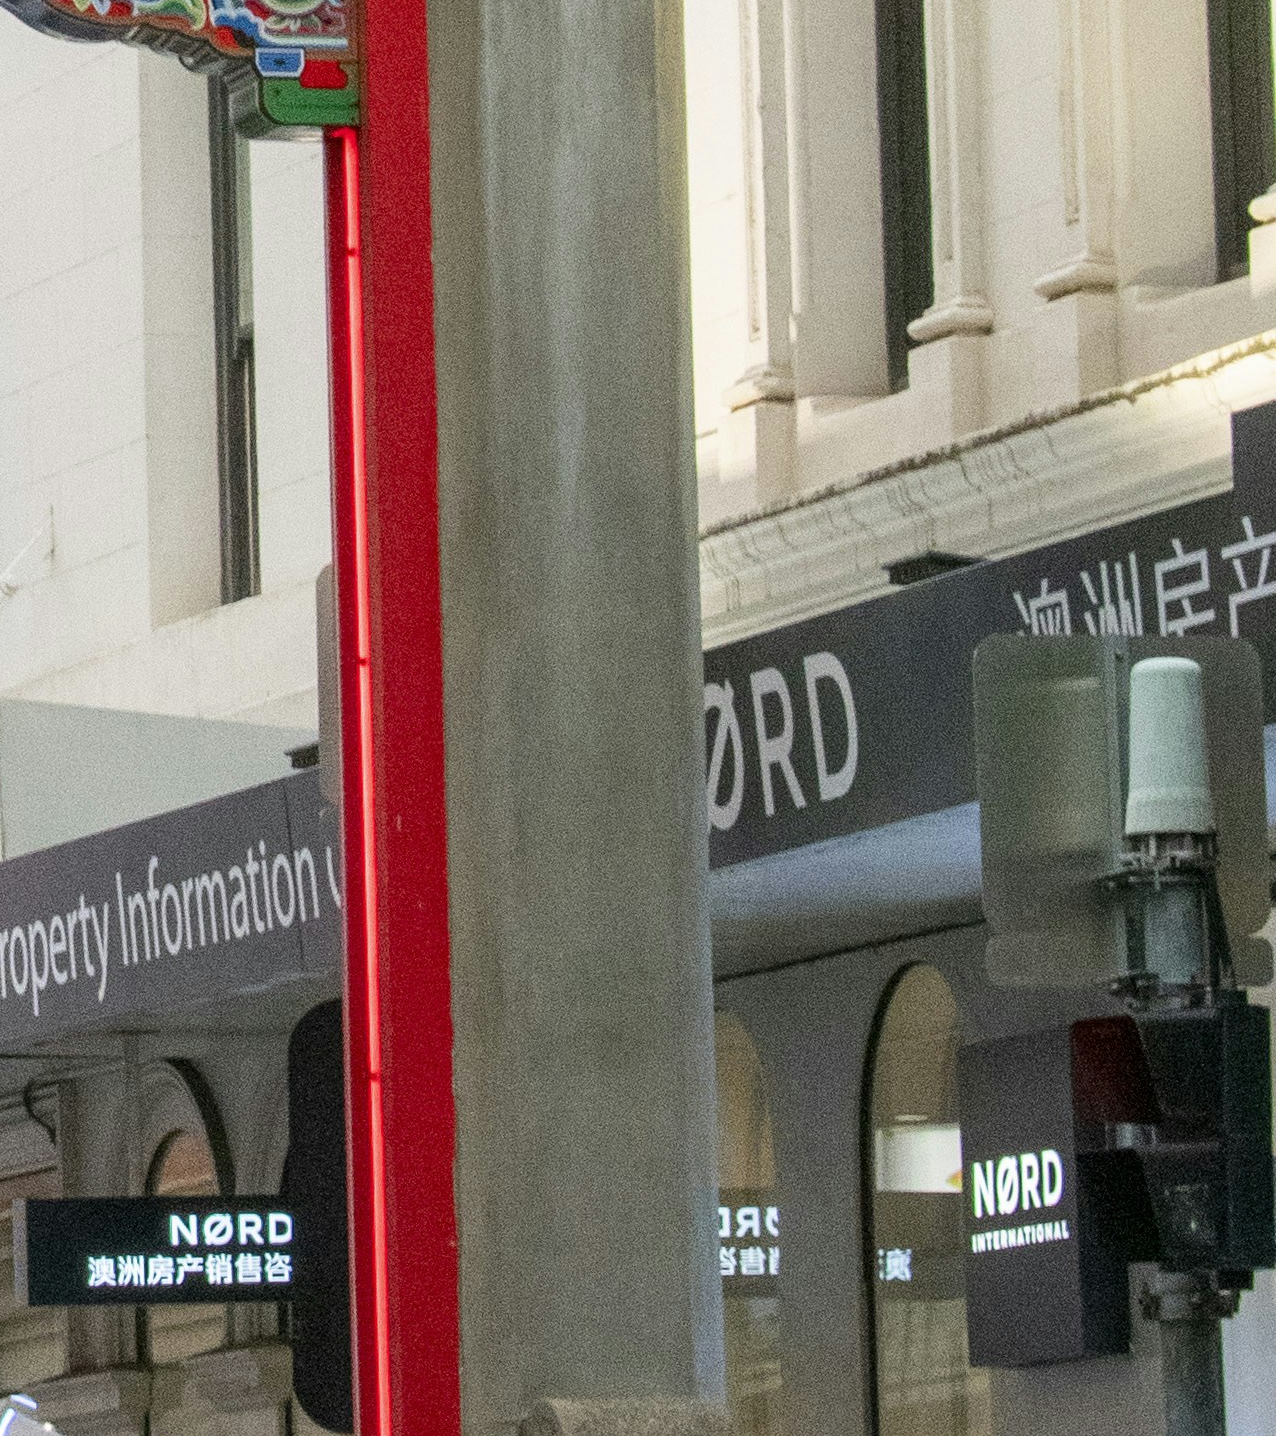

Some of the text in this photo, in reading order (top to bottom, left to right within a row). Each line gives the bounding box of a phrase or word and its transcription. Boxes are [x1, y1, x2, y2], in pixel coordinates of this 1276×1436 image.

[115, 839, 321, 966] Information
[971, 1149, 1065, 1219] NØRD
[170, 1212, 293, 1246] NØRD
[971, 1219, 1071, 1255] INTERNATIONAL
